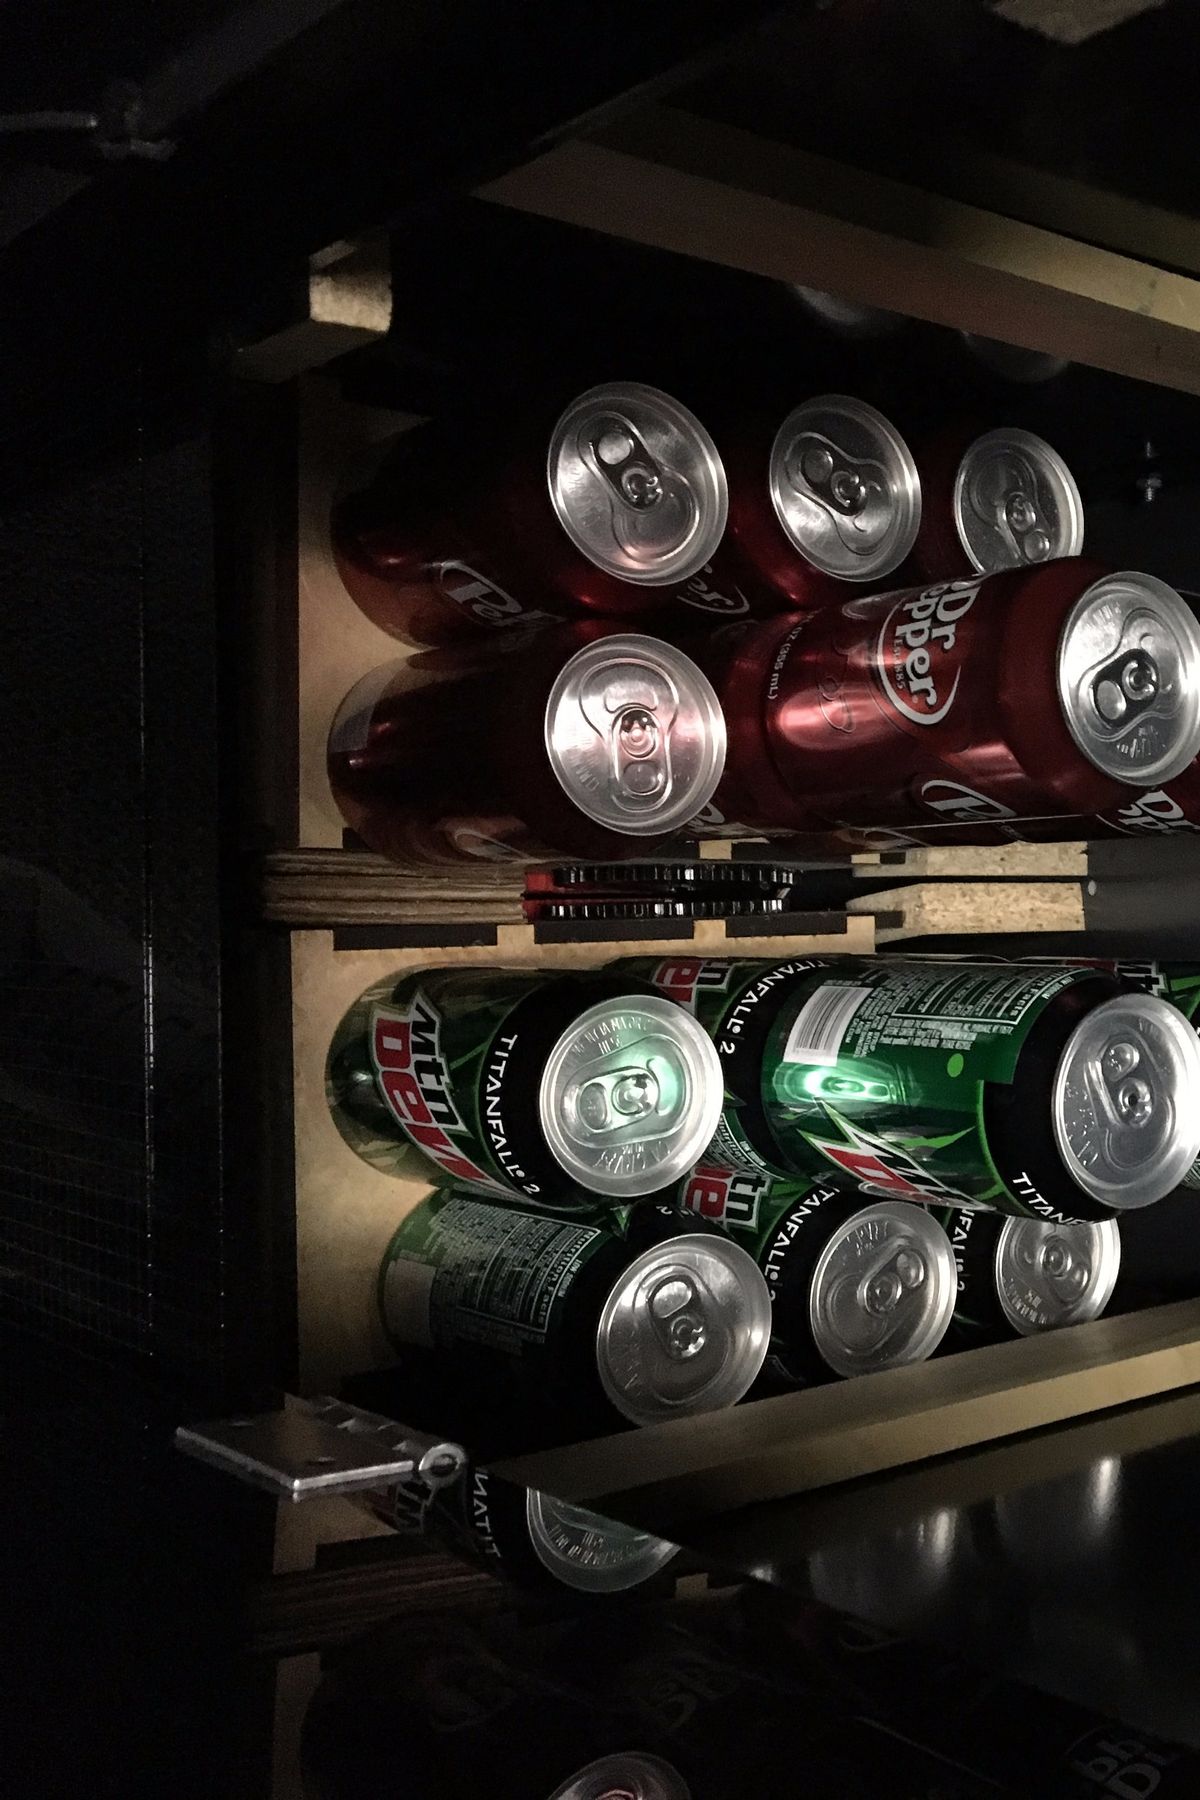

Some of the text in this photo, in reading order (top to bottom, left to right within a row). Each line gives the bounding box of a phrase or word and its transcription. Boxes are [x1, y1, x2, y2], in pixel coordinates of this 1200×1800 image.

[930, 585, 981, 651] Dr
[767, 673, 780, 700] mL)
[774, 643, 791, 670] (355
[411, 1006, 460, 1125] Mtn
[719, 1040, 735, 1054] 2
[485, 1034, 540, 1195] TITANFALL 2
[538, 1230, 593, 1325] Nutrition Facts
